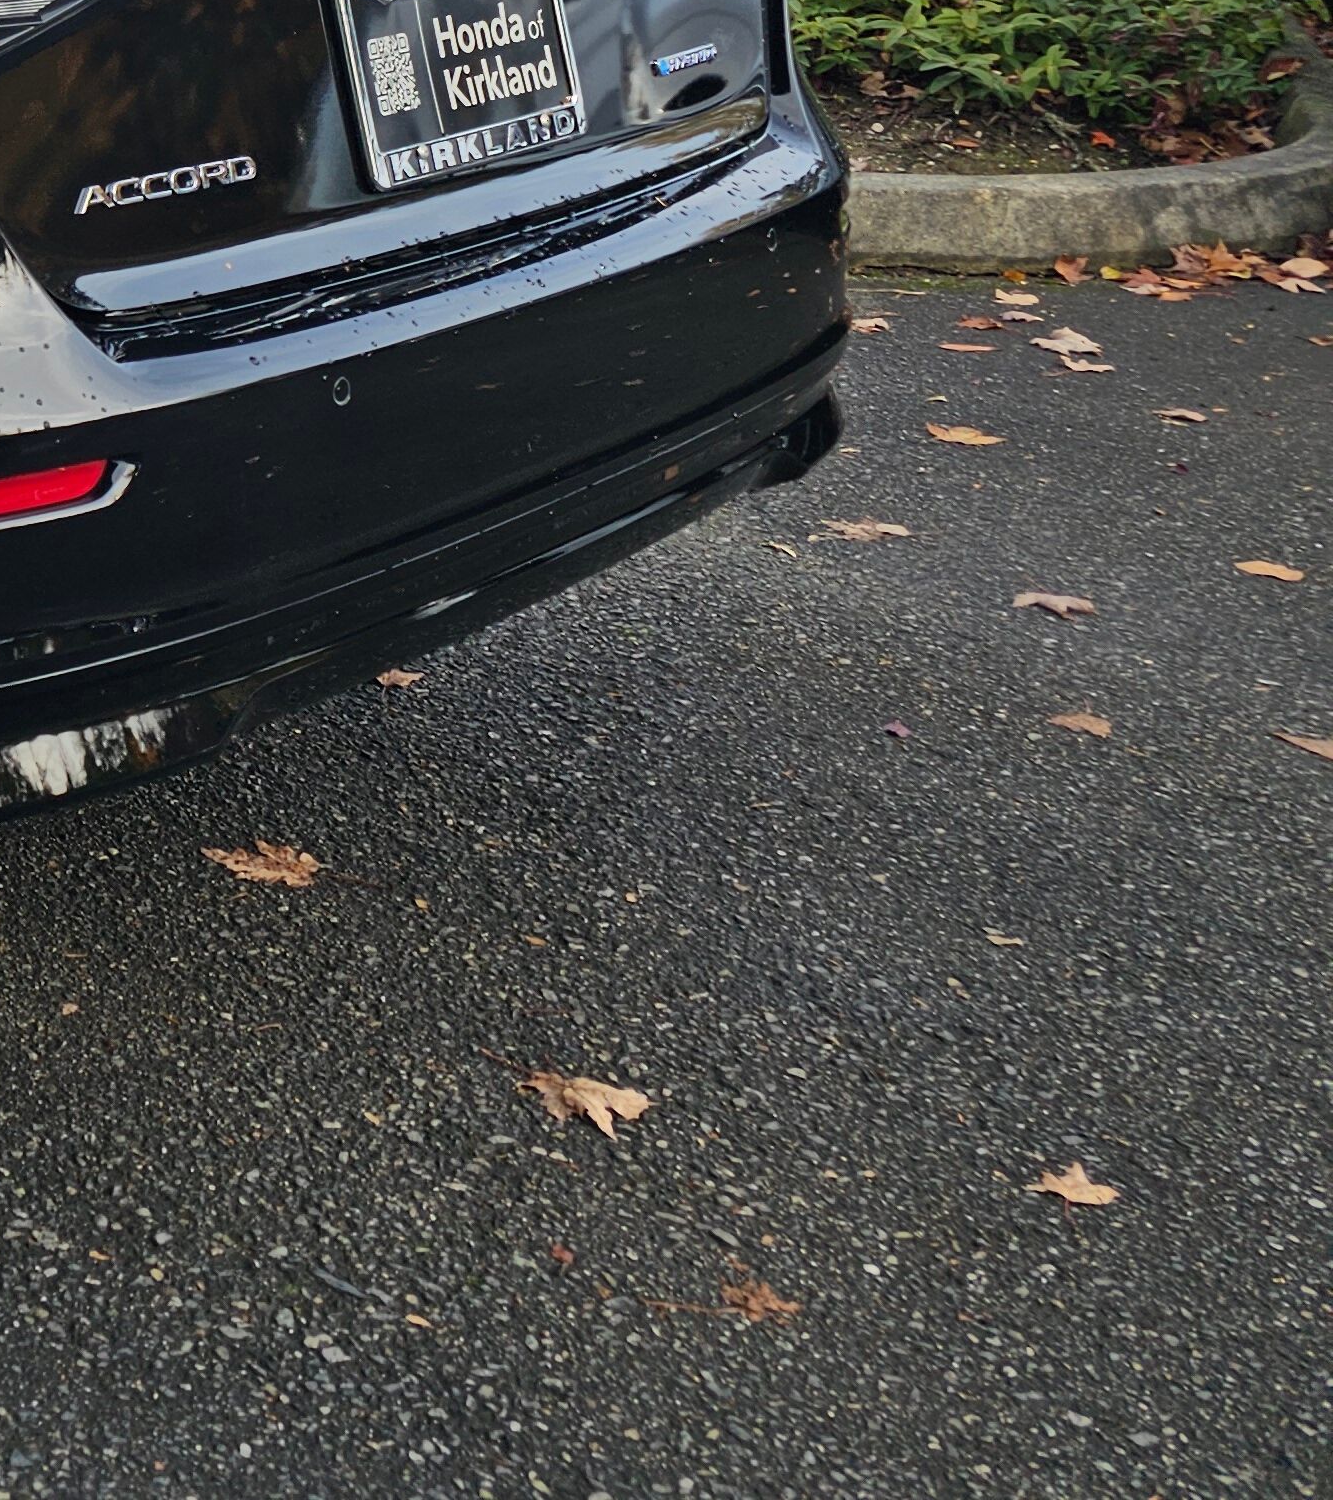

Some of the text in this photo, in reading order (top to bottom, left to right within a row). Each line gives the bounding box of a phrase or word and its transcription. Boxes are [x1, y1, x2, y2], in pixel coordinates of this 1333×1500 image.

[433, 1, 545, 58] Honda of
[443, 44, 558, 110] Kirkland
[390, 110, 575, 182] KIRKLAND
[73, 156, 257, 215] ACCORD
